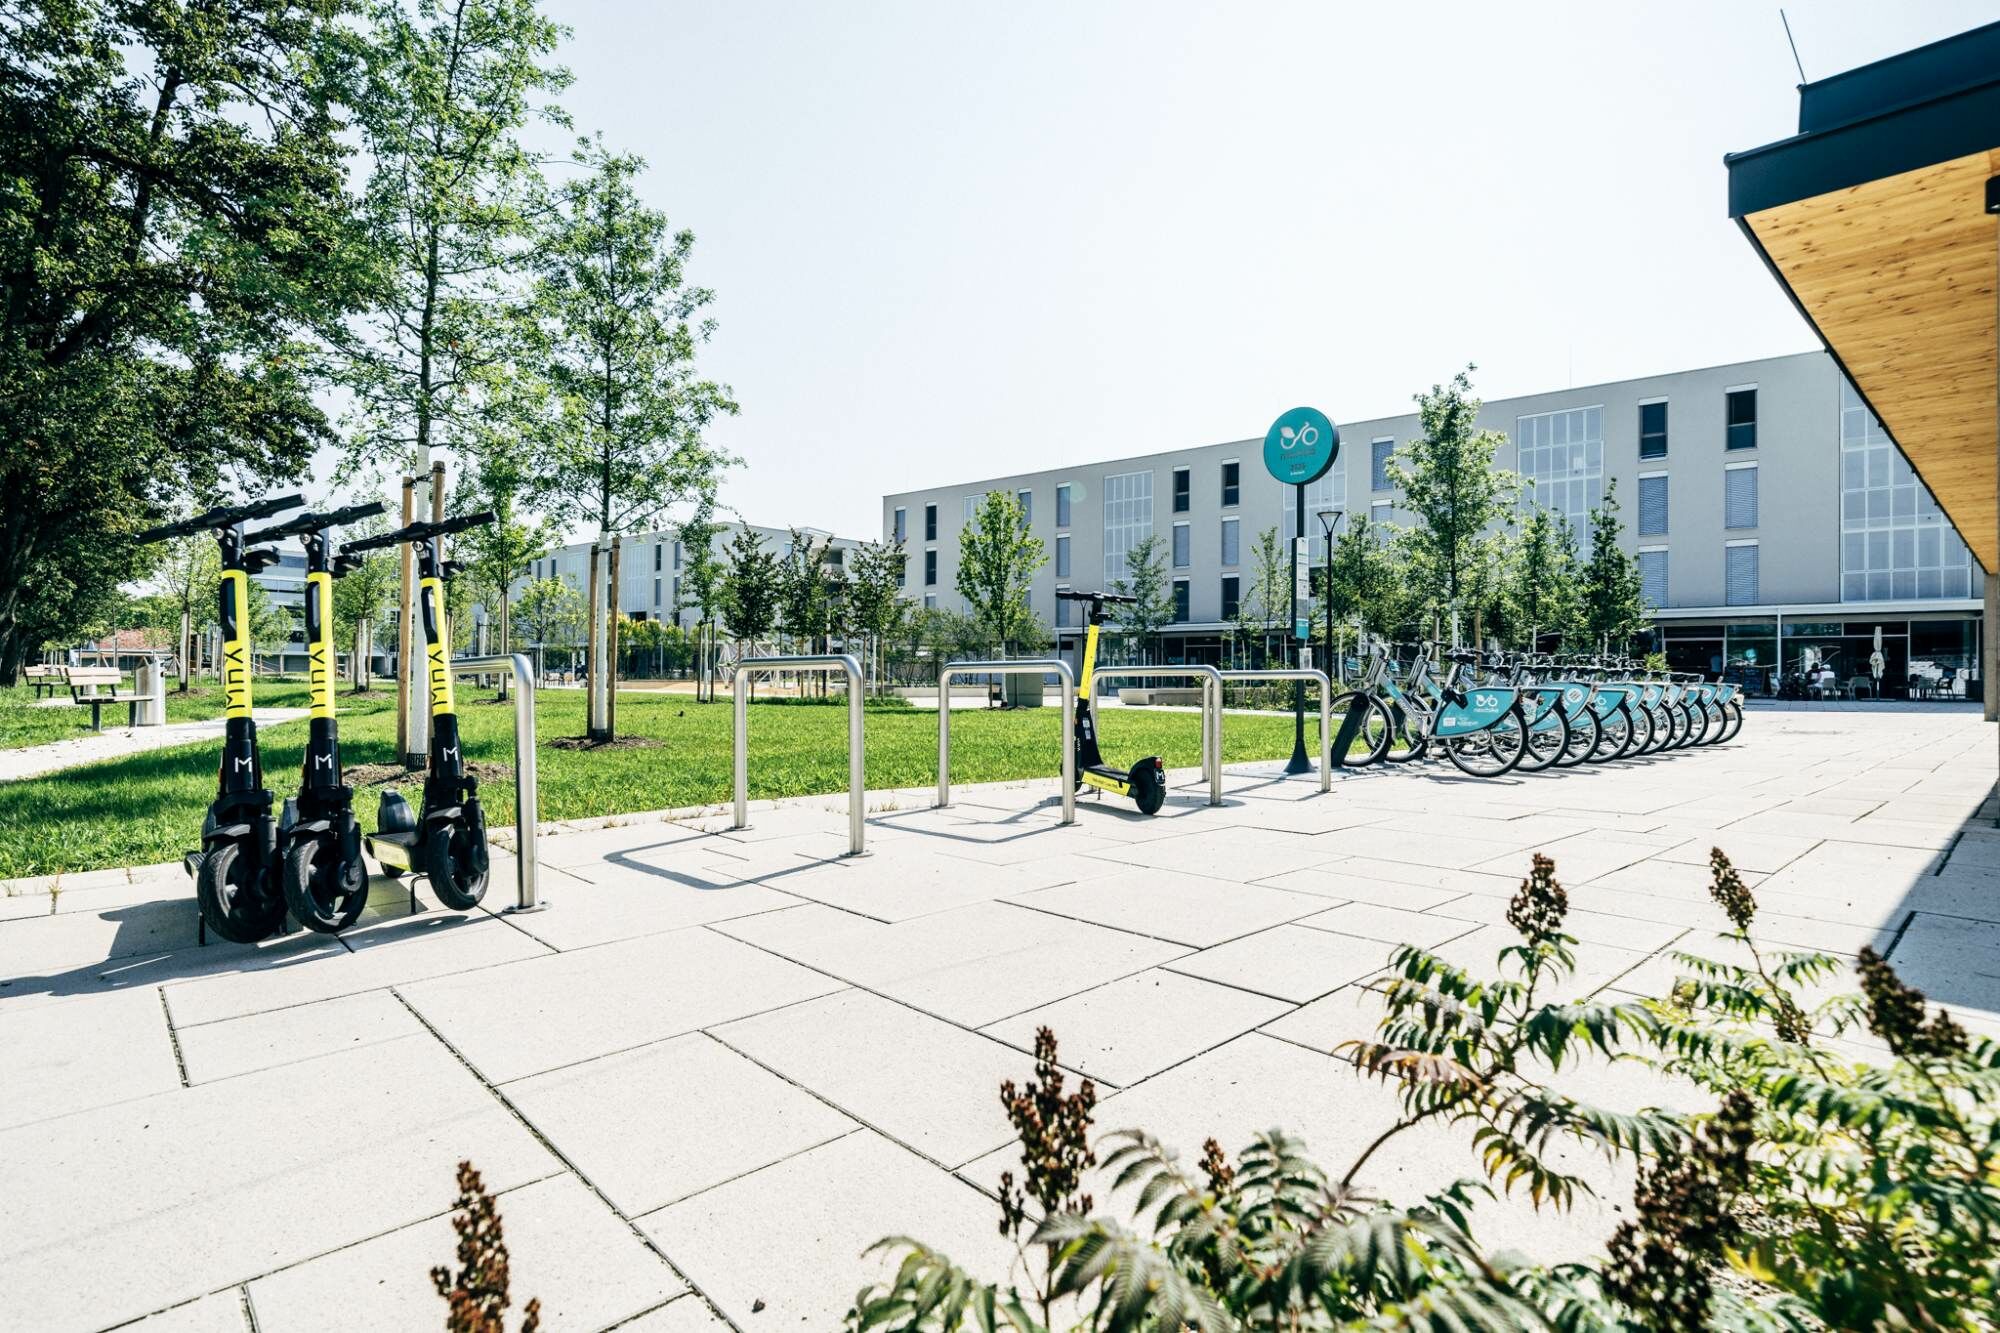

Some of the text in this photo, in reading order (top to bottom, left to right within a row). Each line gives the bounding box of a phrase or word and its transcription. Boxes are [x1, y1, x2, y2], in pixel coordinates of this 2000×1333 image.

[315, 753, 333, 770] M
[443, 746, 459, 762] M
[234, 756, 252, 773] M
